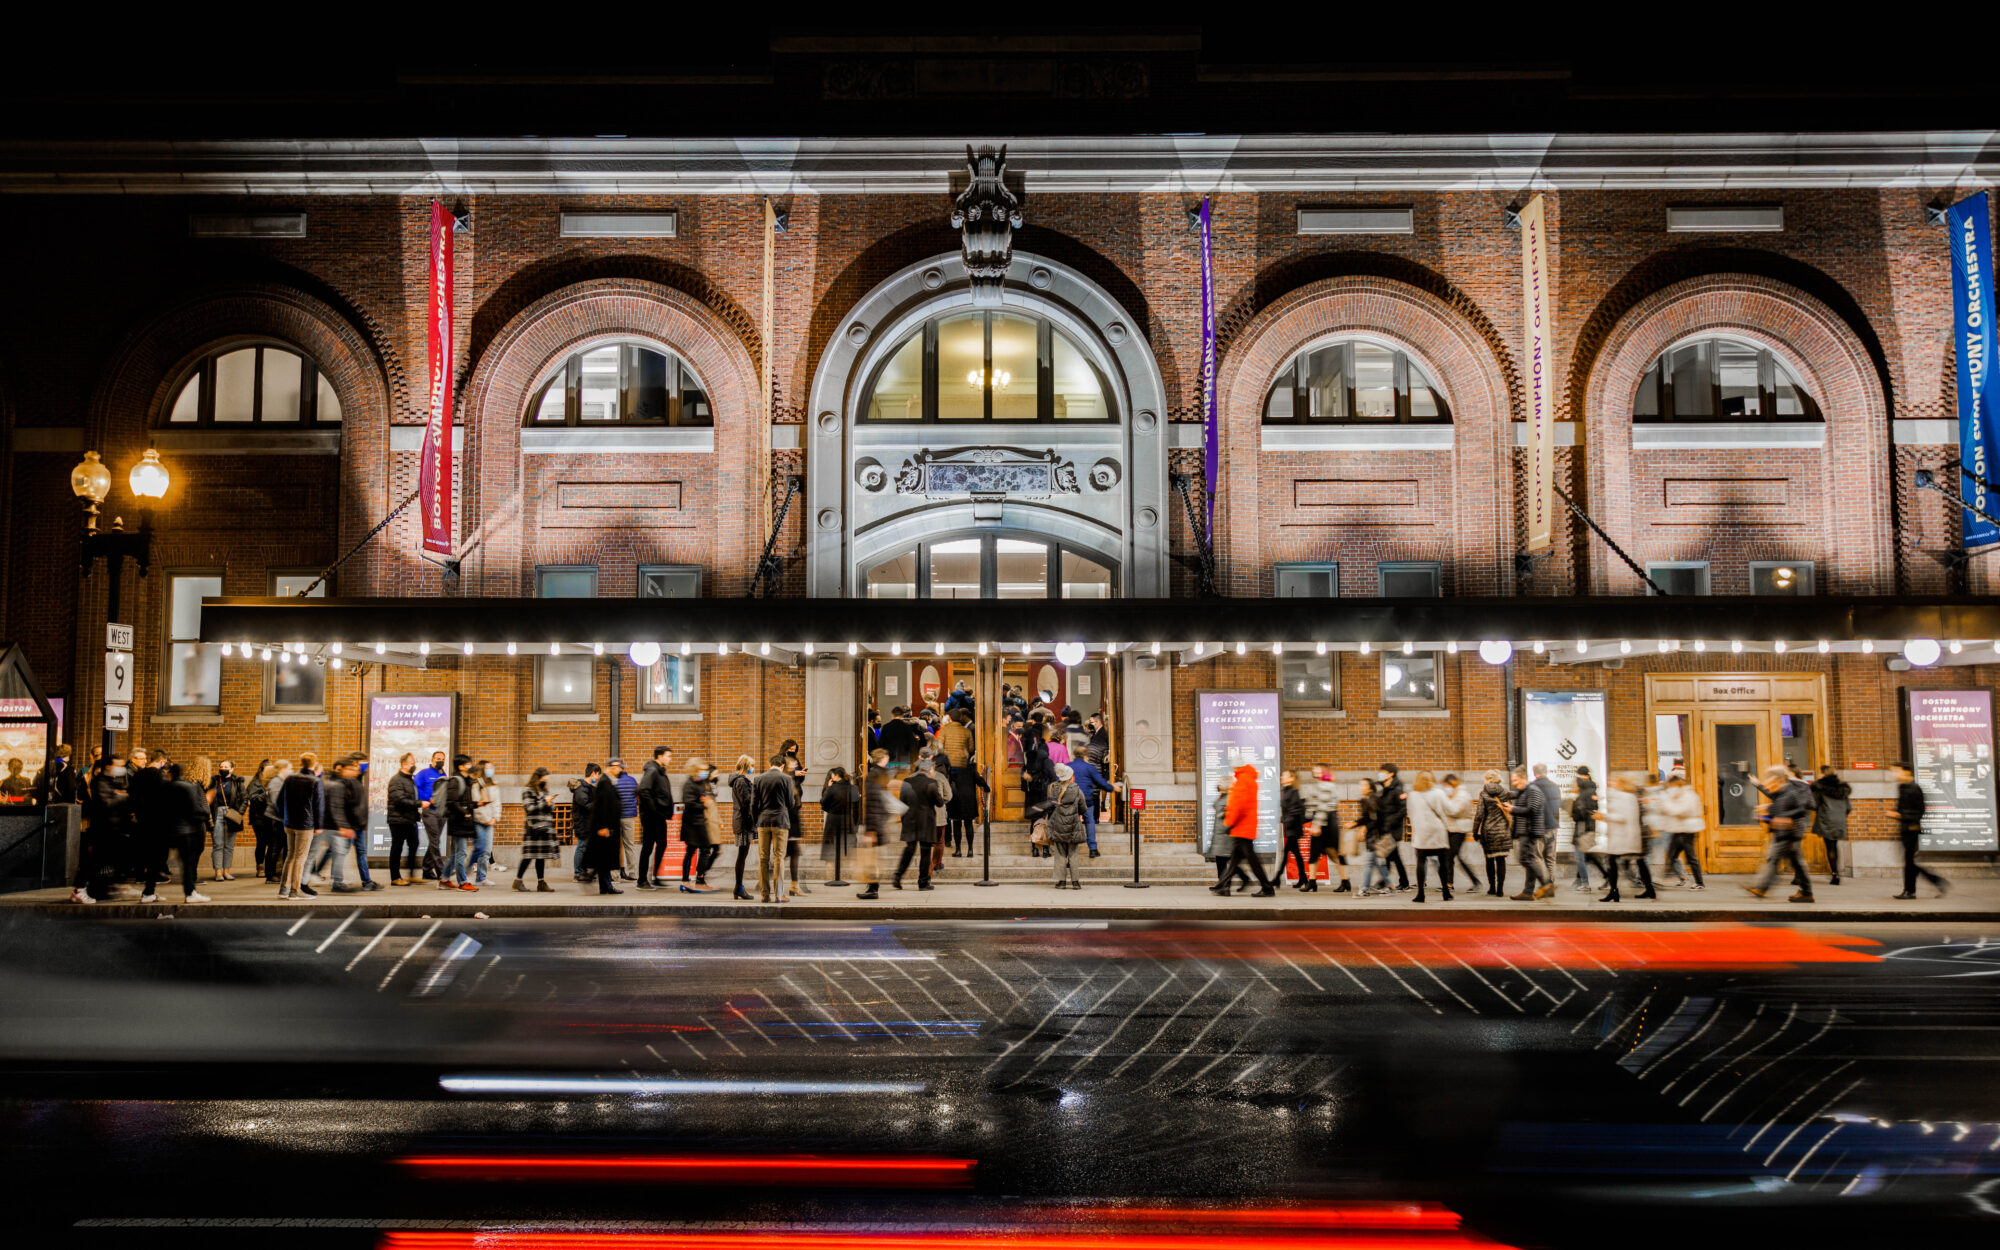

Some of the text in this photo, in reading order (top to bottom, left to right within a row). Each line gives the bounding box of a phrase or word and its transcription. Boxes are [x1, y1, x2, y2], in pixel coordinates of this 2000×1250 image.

[1530, 219, 1542, 329] ORCHESTRA
[1962, 215, 1983, 328] ORCHESTRA
[111, 628, 130, 645] WEST
[114, 665, 124, 690] 9
[1731, 686, 1755, 694] Office
